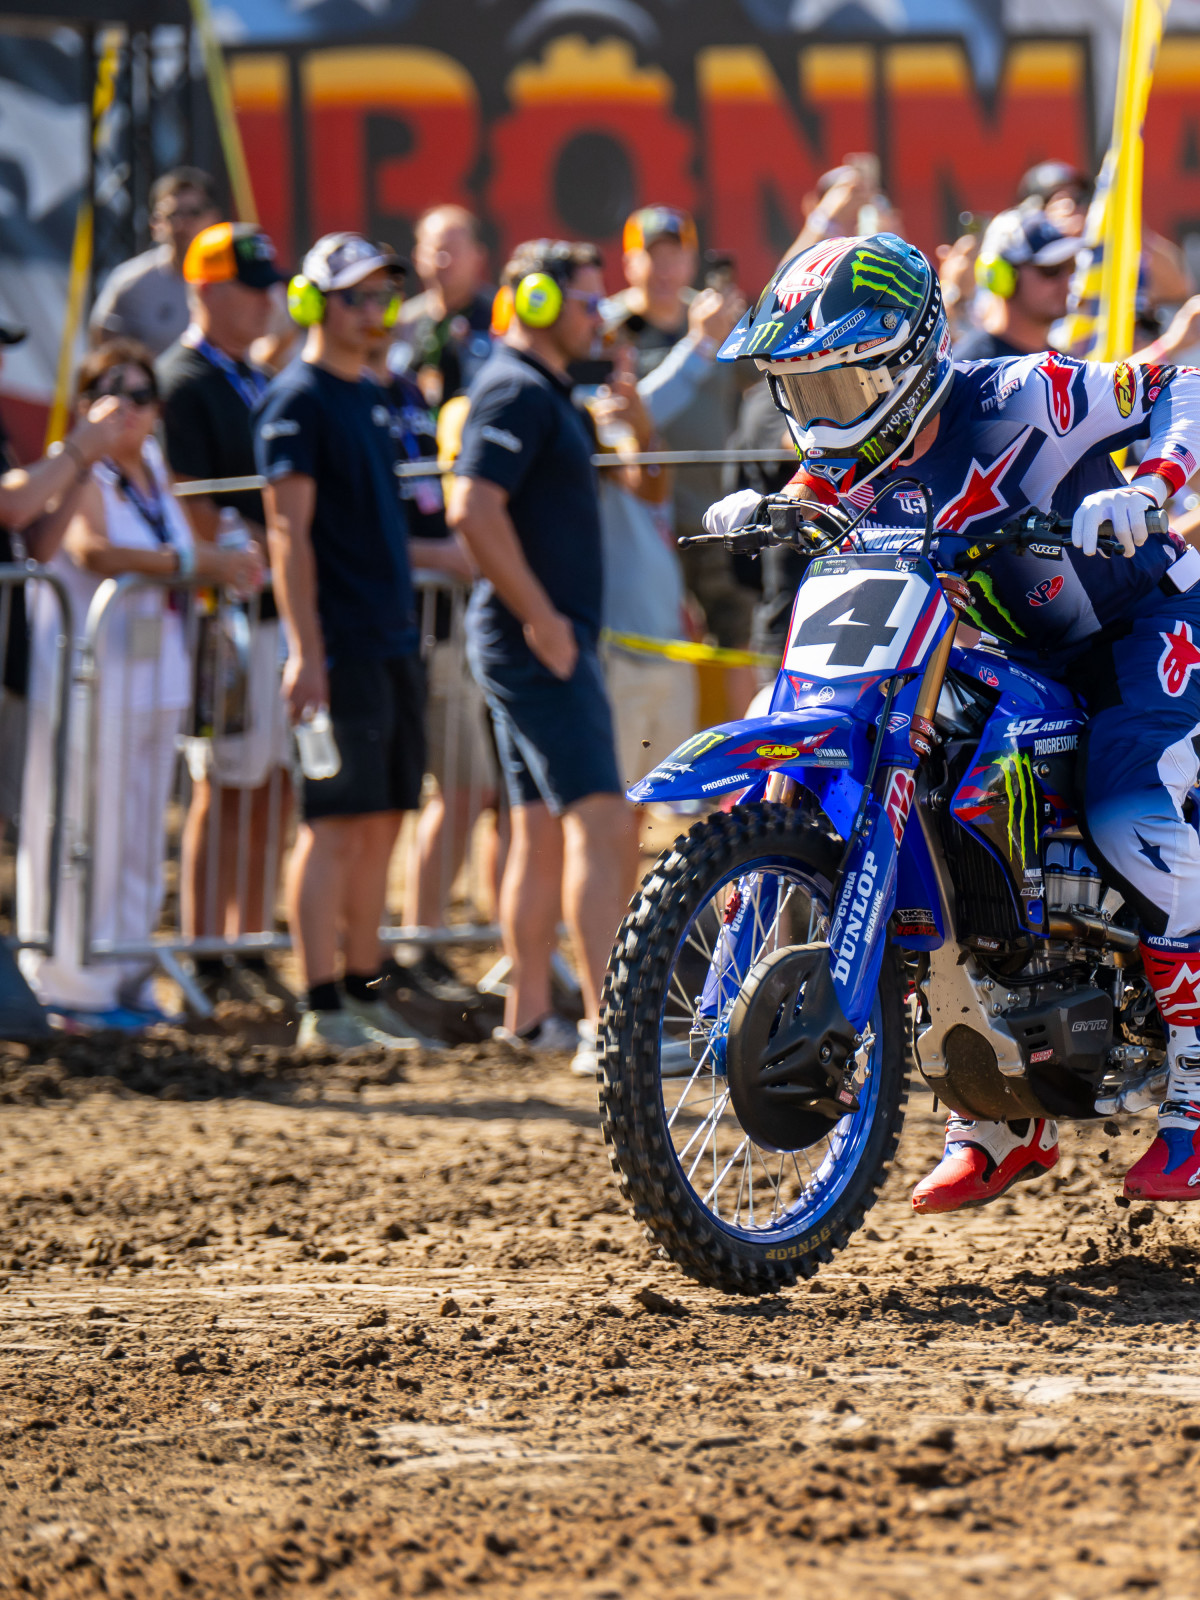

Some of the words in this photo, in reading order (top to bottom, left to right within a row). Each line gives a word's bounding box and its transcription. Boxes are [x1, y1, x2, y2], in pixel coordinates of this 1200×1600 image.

[822, 310, 866, 348] apdesigns
[899, 277, 941, 364] OAKLEY
[880, 370, 935, 437] MONSTER
[1029, 544, 1061, 555] ARC
[792, 578, 908, 666] 4
[1003, 718, 1043, 737] YZ
[761, 746, 798, 756] FMF
[819, 748, 848, 757] YAMAHA
[1034, 735, 1079, 756] PROGRESSIVE
[702, 773, 750, 792] PROGRESSIVE
[838, 871, 857, 917] CYCRA
[834, 851, 878, 986] DUNLOP
[863, 888, 884, 944] BRAKING
[1148, 936, 1172, 947] MXON
[1072, 1020, 1108, 1032] GYTR
